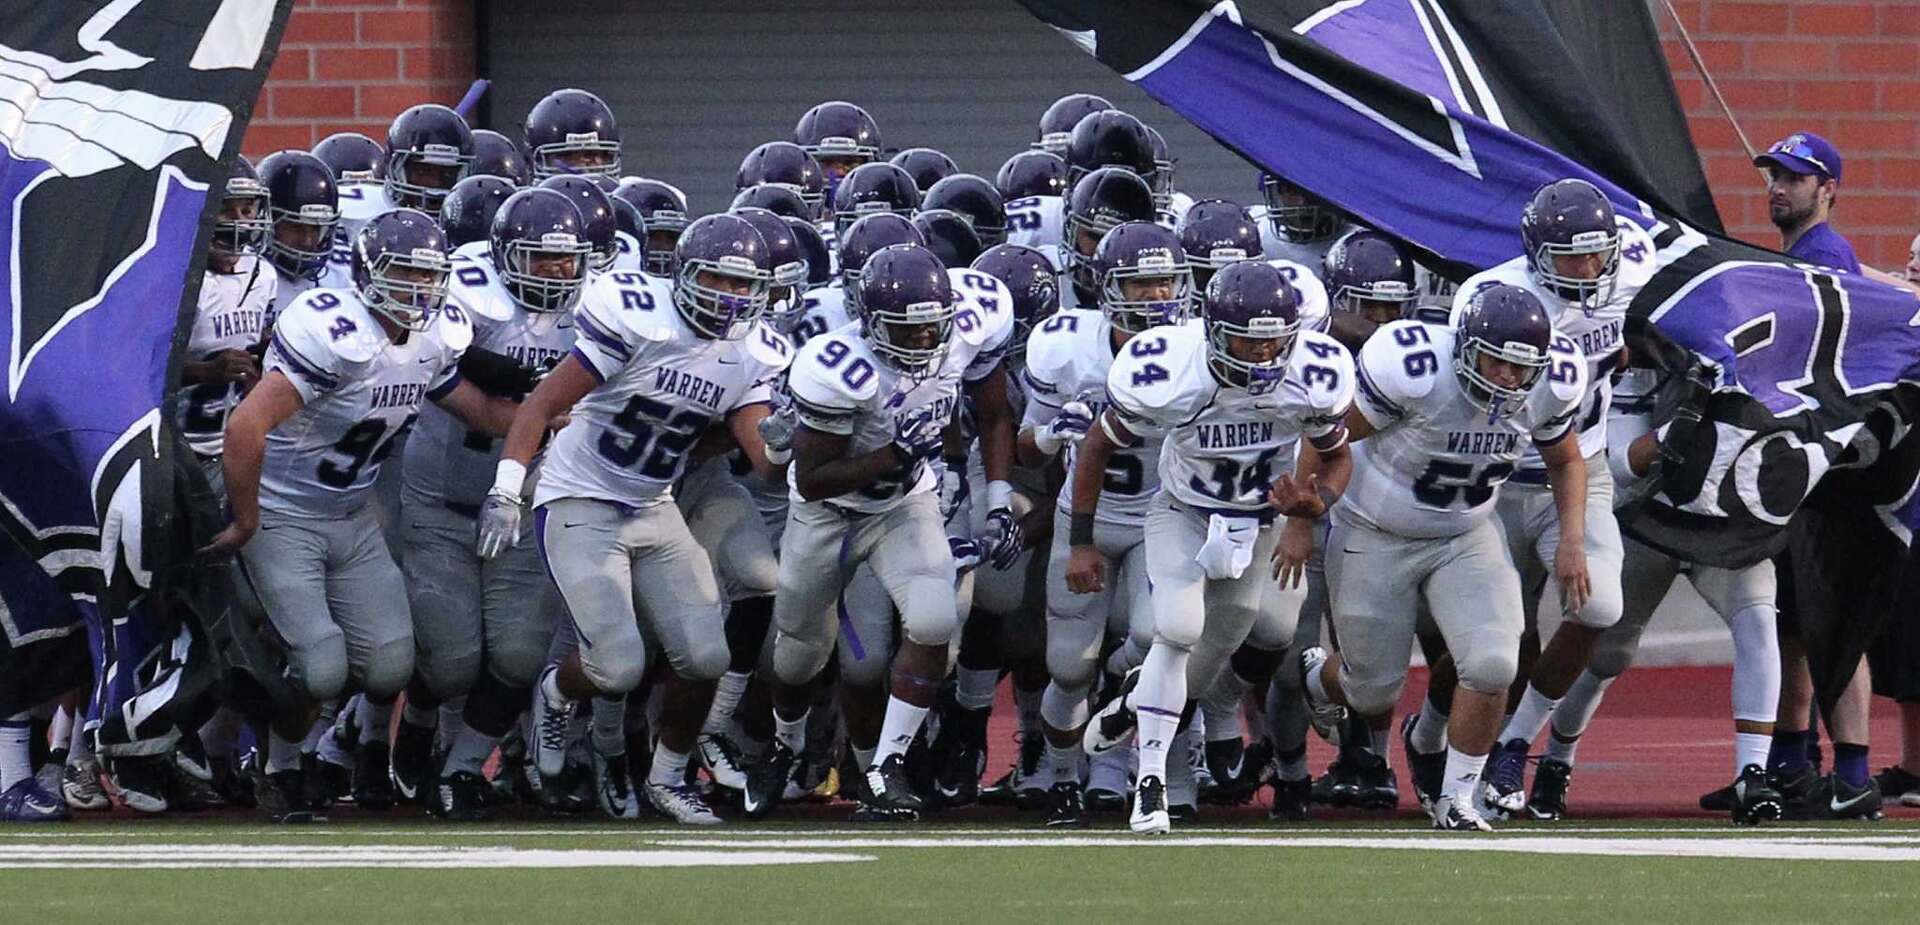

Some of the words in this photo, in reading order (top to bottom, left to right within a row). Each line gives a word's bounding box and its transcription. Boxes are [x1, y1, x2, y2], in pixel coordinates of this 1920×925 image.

[612, 271, 656, 313] 52
[212, 310, 262, 339] WARREN
[306, 292, 357, 341] 94
[1043, 315, 1080, 334] 5
[816, 340, 874, 392] 90
[1131, 337, 1170, 389] 34
[1303, 340, 1341, 391] 34
[1390, 324, 1438, 380] 56
[1547, 335, 1578, 385] 56
[370, 383, 427, 409] WARREN
[655, 366, 726, 409] WARREN
[598, 394, 711, 480] 52
[1197, 421, 1274, 449] WARREN
[1447, 431, 1519, 455] WARREN
